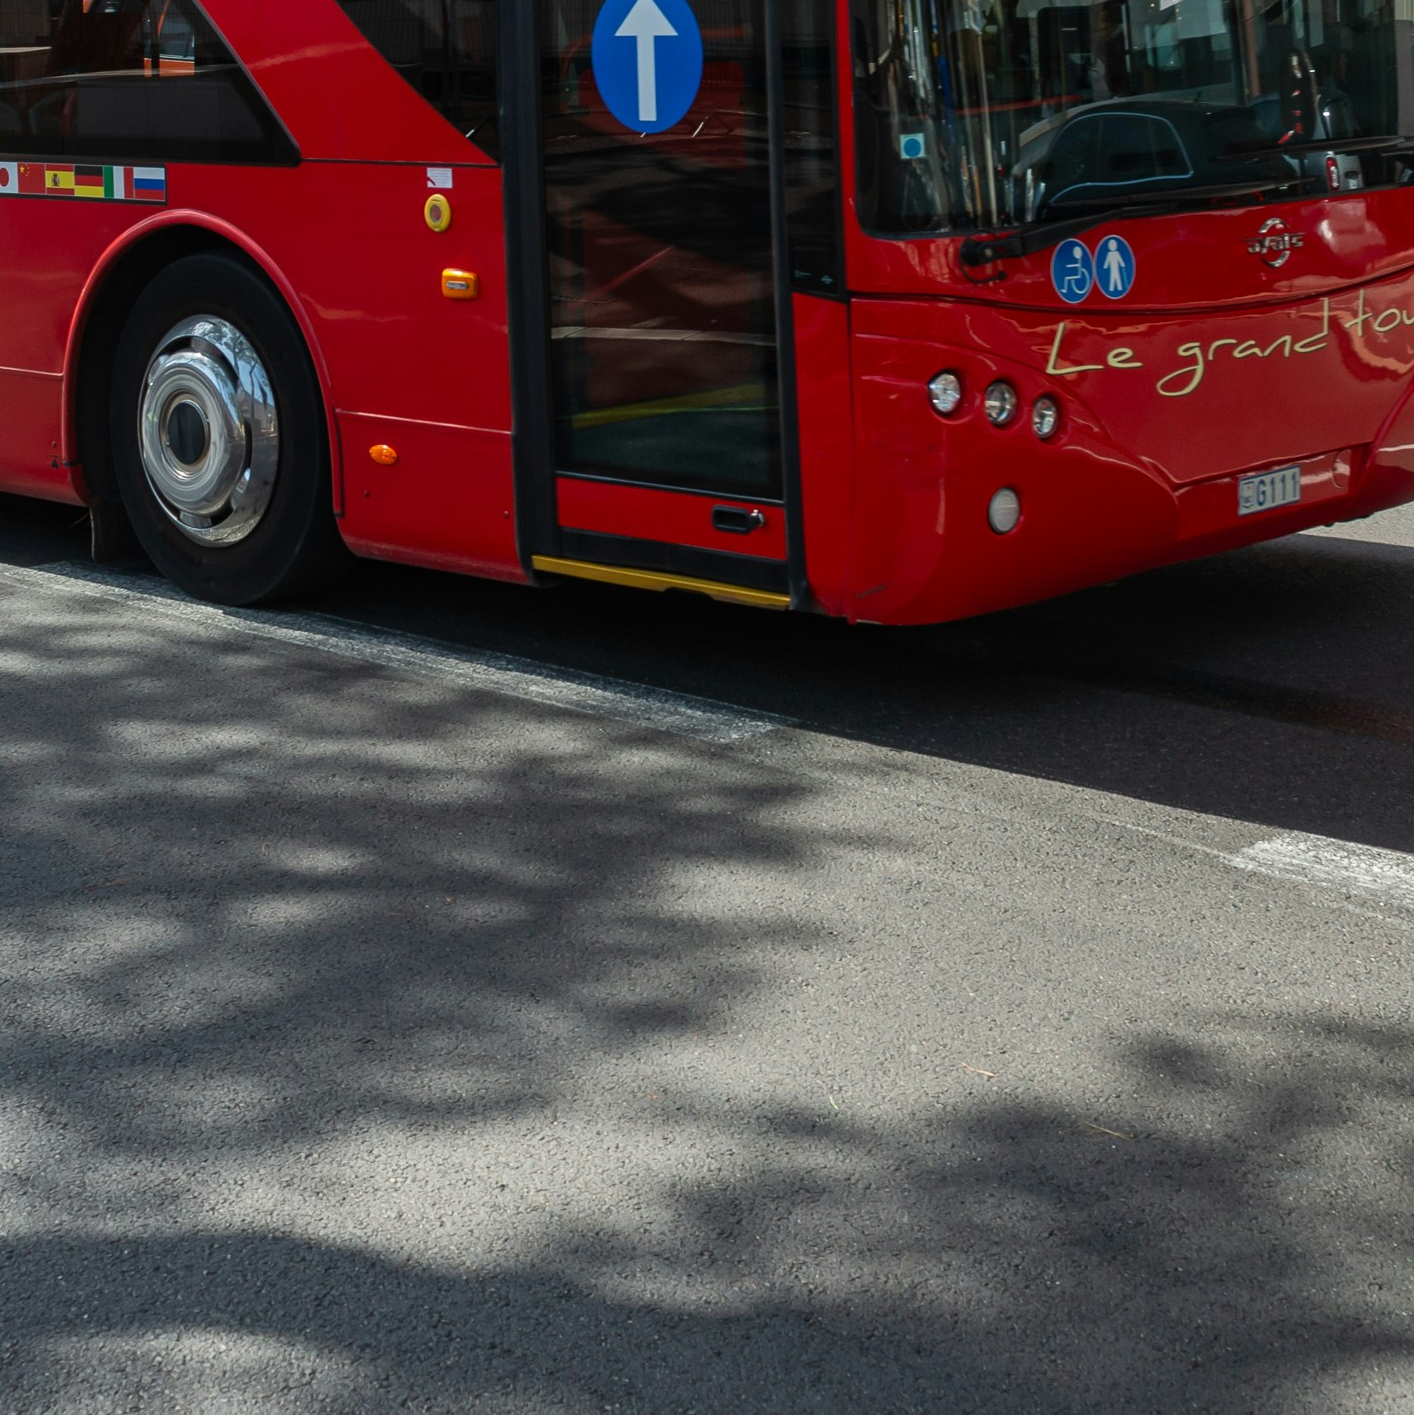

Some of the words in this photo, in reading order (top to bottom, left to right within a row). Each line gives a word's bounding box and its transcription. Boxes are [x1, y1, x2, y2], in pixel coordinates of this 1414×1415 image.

[1046, 322, 1143, 375] Le
[1156, 298, 1330, 396] grand
[1256, 471, 1298, 506] G111
